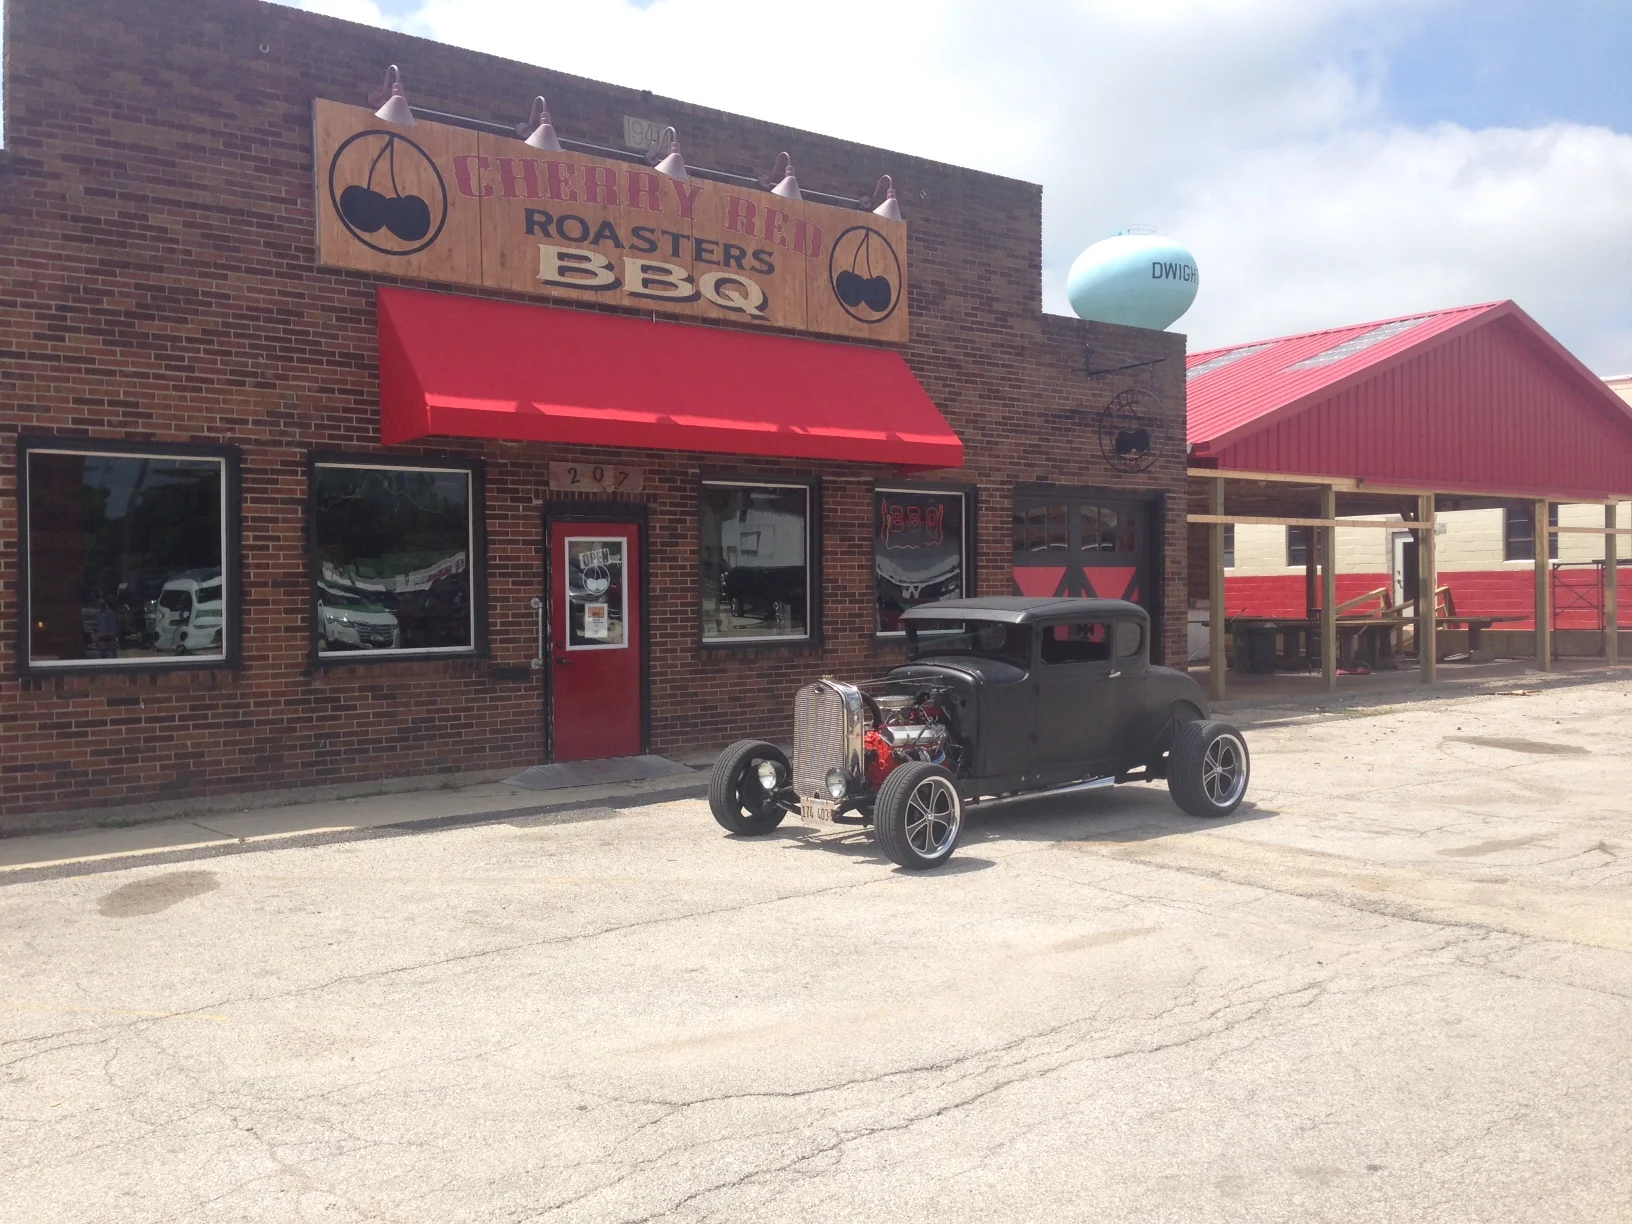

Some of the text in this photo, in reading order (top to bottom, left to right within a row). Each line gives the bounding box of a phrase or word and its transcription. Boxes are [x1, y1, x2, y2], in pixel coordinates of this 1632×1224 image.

[453, 154, 824, 260] CHERRY RED
[524, 207, 775, 275] ROASTERS
[535, 243, 771, 322] BBQ
[567, 465, 629, 487] 207
[582, 548, 609, 567] OPEN
